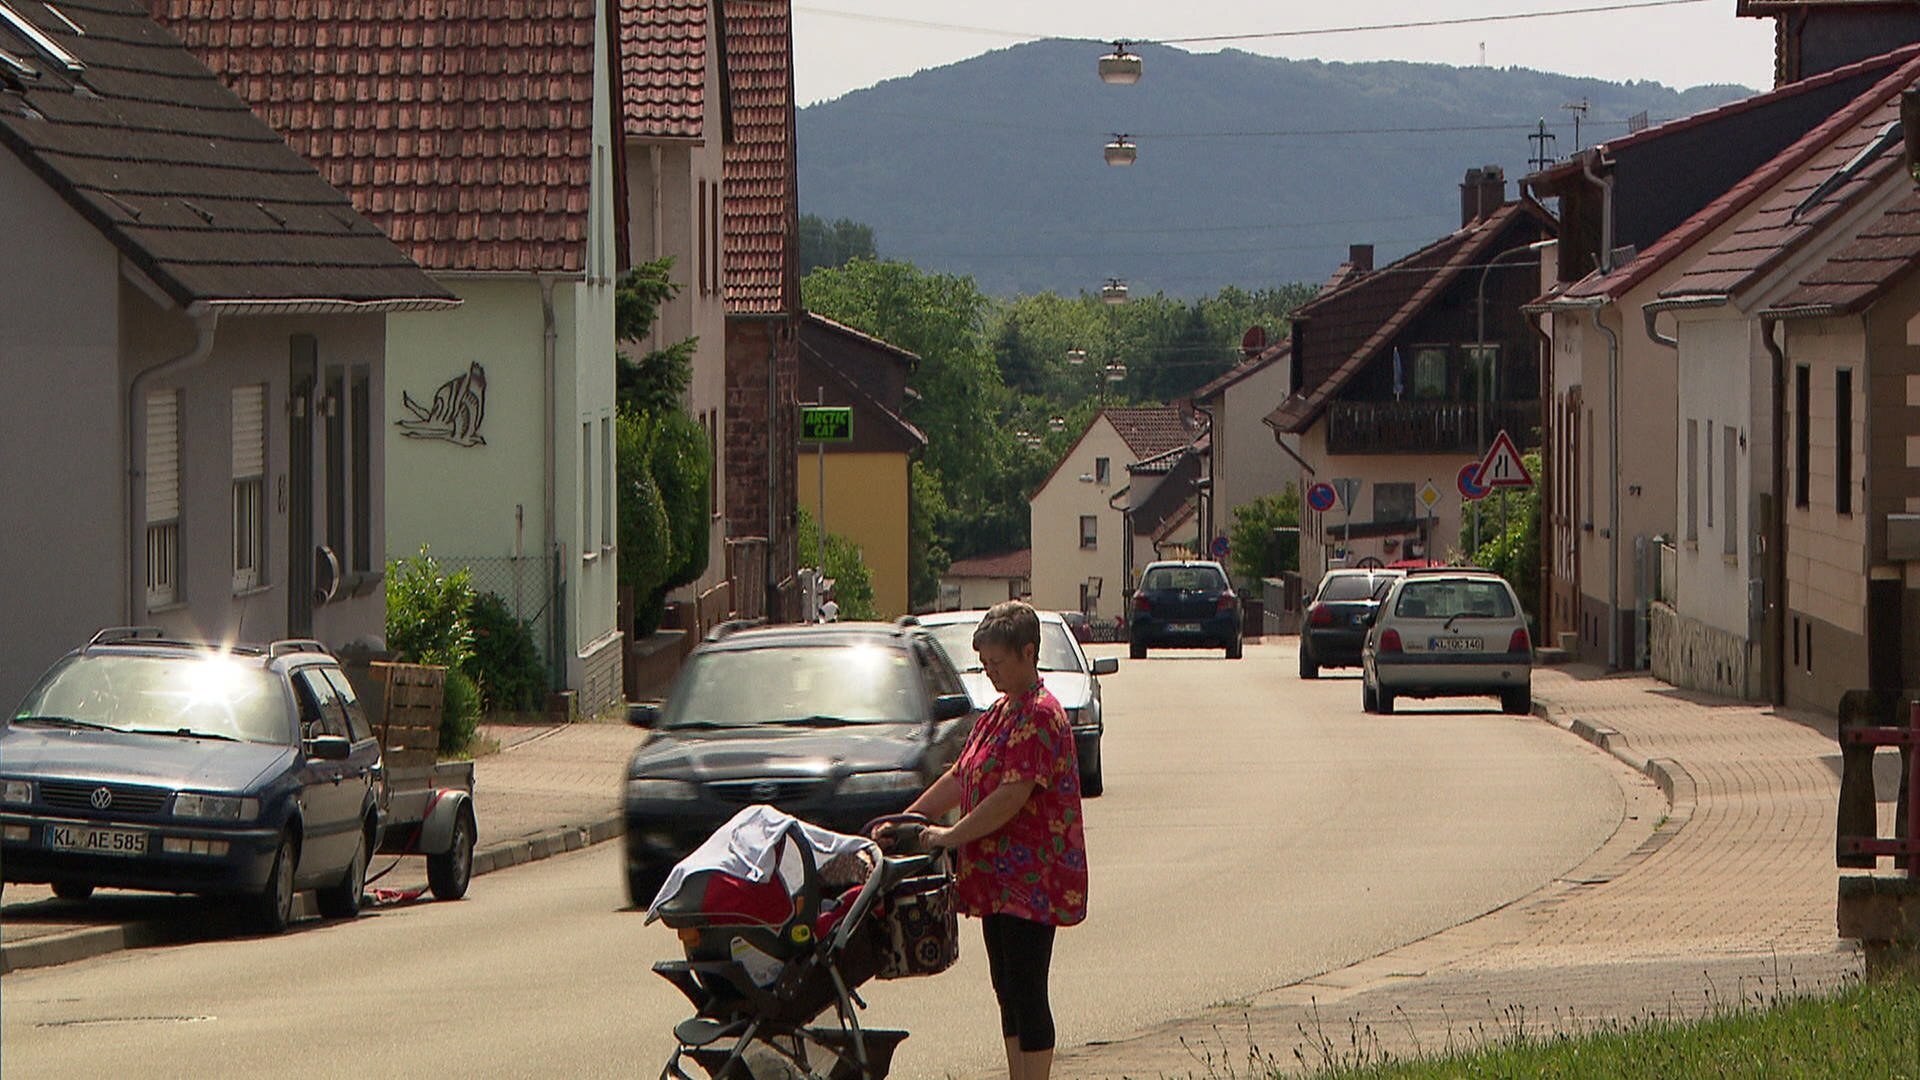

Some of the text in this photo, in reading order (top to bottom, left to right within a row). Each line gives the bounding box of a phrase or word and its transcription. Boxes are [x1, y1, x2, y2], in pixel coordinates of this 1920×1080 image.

[805, 411, 848, 424] ARCTIC
[815, 424, 838, 437] CAT
[54, 827, 145, 852] KL AE 585
